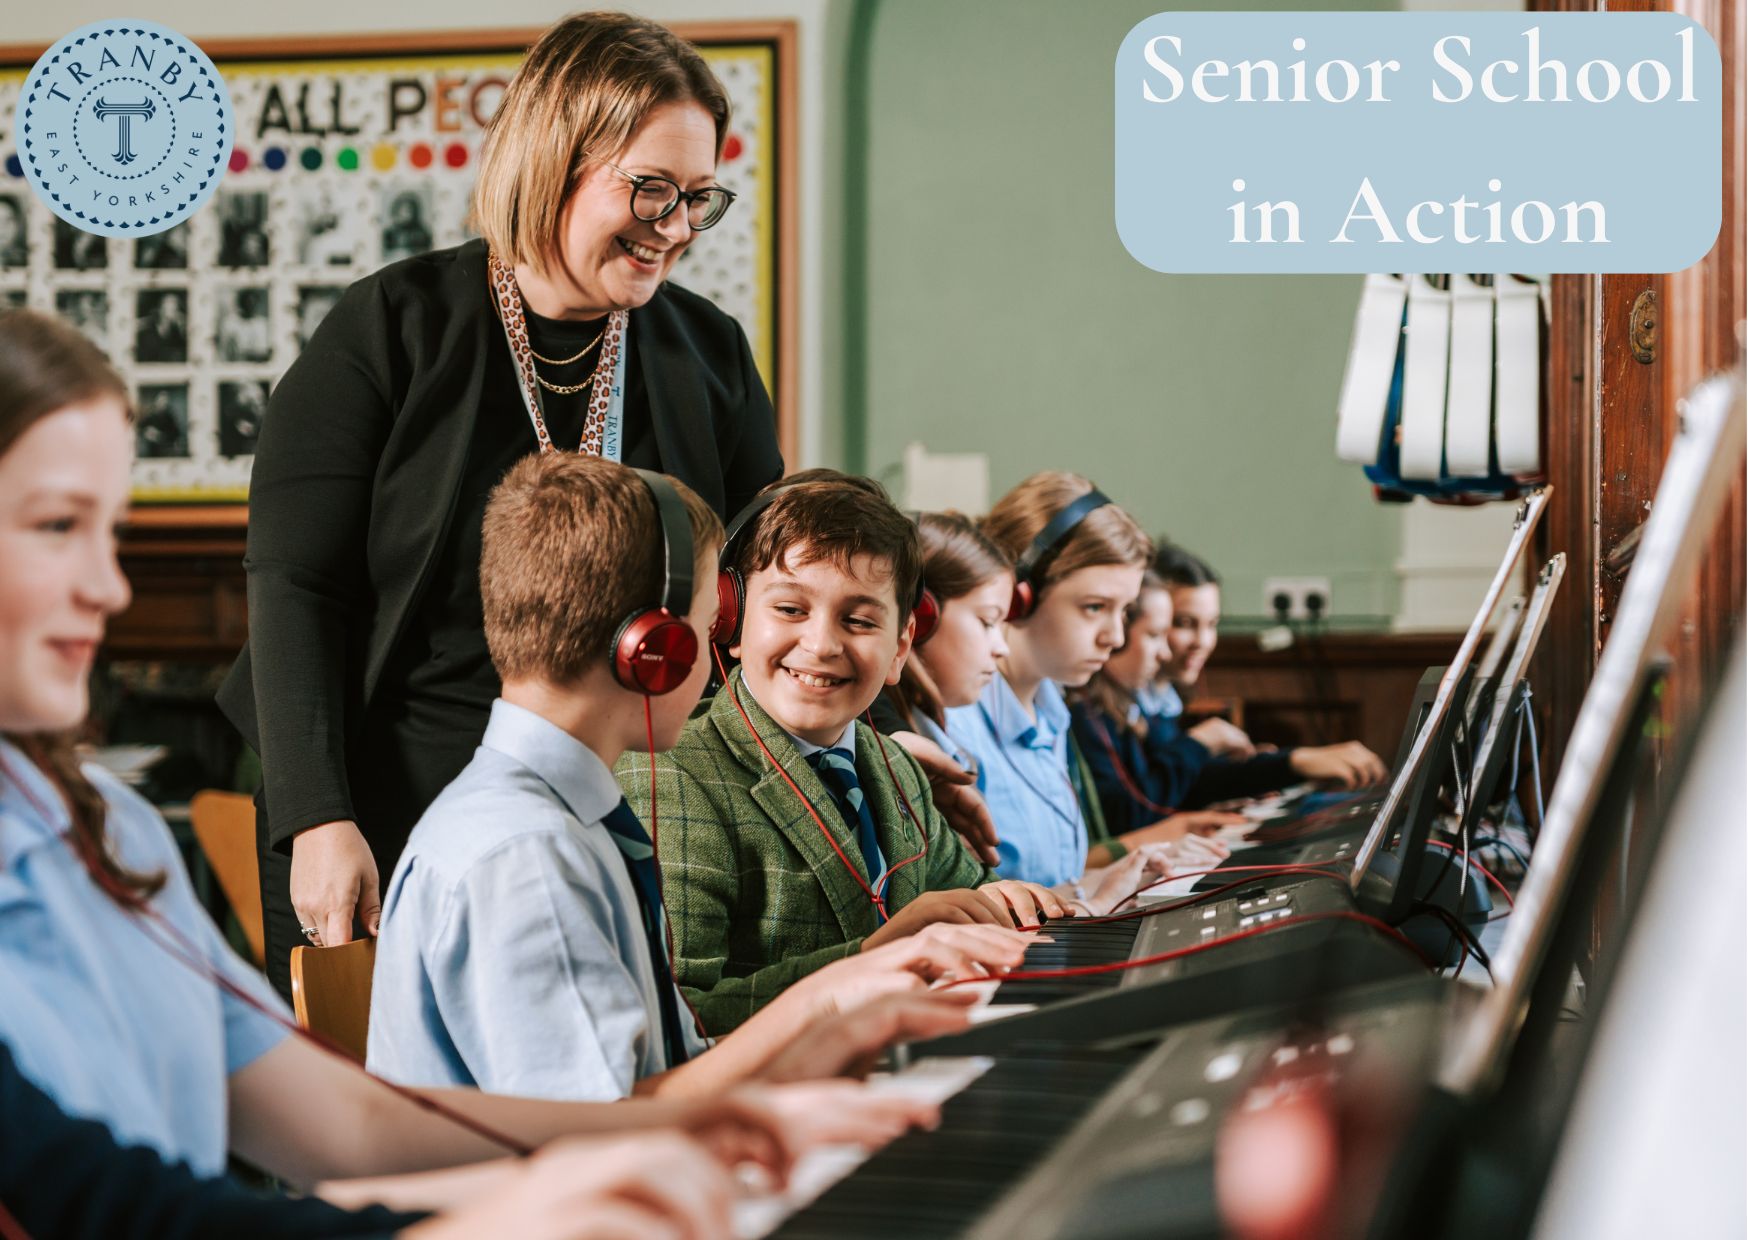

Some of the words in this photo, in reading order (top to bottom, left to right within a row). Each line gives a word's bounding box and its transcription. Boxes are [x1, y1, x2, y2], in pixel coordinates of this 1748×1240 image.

[257, 80, 360, 138] ALL
[607, 415, 618, 459] TRANBY
[641, 653, 664, 662] SONY
